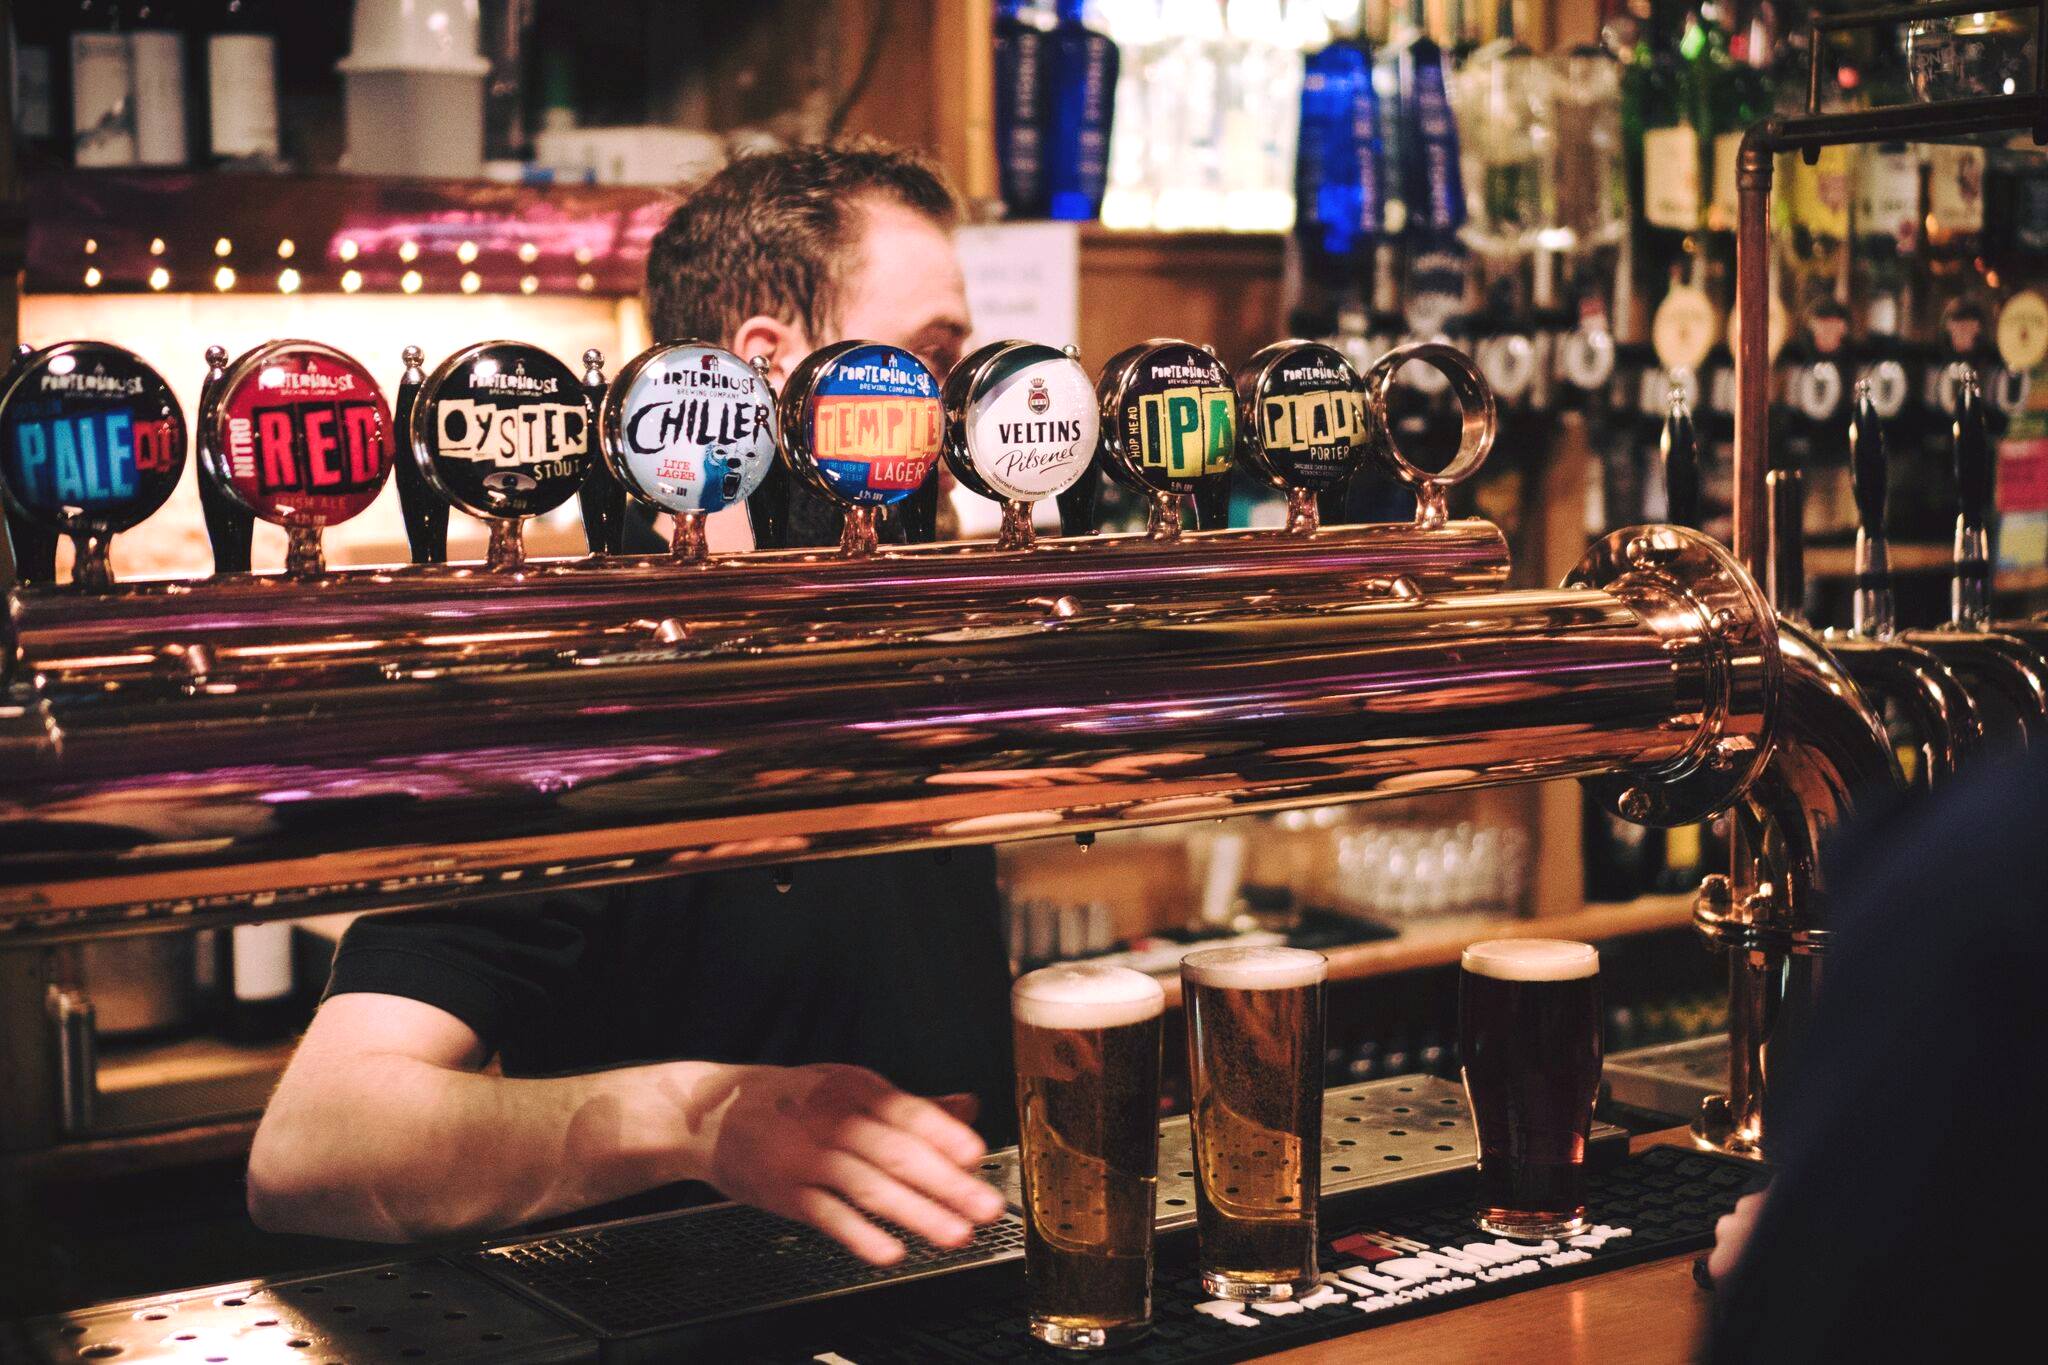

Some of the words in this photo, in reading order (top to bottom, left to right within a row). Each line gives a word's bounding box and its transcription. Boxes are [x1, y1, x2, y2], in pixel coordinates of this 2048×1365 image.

[259, 373, 355, 391] TERHOUSE
[1151, 365, 1221, 382] PORTERHOUSE
[1283, 367, 1351, 383] PORTERHOUSE
[859, 383, 887, 392] BREWING
[888, 385, 916, 395] COMPANY
[626, 399, 775, 454] CHILLER
[820, 405, 937, 452] TEMPLE
[998, 420, 1081, 444] VELTINS
[1127, 406, 1139, 434] HEAD
[1265, 399, 1369, 444] PLAIN
[444, 409, 584, 459] OYSTER
[1145, 397, 1233, 470] IPA
[18, 414, 134, 501] PALE
[229, 418, 255, 477] NITRO
[259, 406, 380, 487] RED
[1129, 438, 1140, 458] HOP
[1310, 445, 1350, 460] PORTER
[533, 460, 580, 481] STOUT
[663, 459, 691, 470] LITE
[874, 462, 925, 482] LAGER
[995, 442, 1080, 478] Pilsener
[656, 467, 696, 481] LAGER
